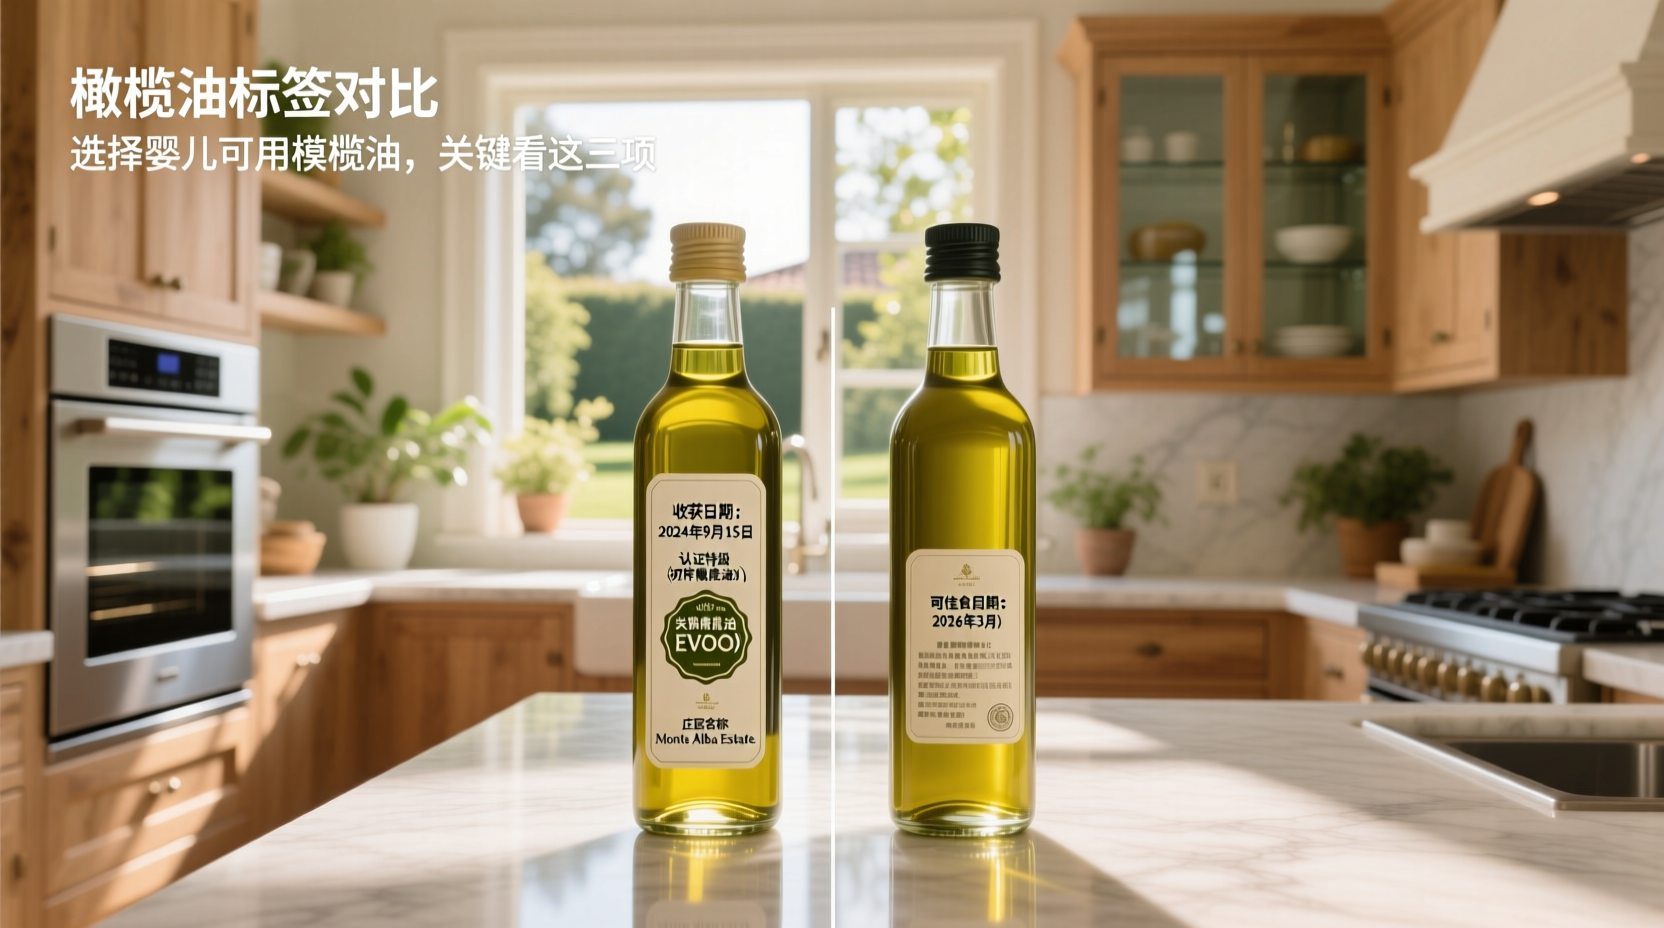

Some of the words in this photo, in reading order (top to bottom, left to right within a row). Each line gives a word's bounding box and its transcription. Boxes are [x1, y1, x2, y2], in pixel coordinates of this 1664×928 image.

[658, 524, 753, 540] 2024年9月15日
[655, 732, 690, 745] Monte
